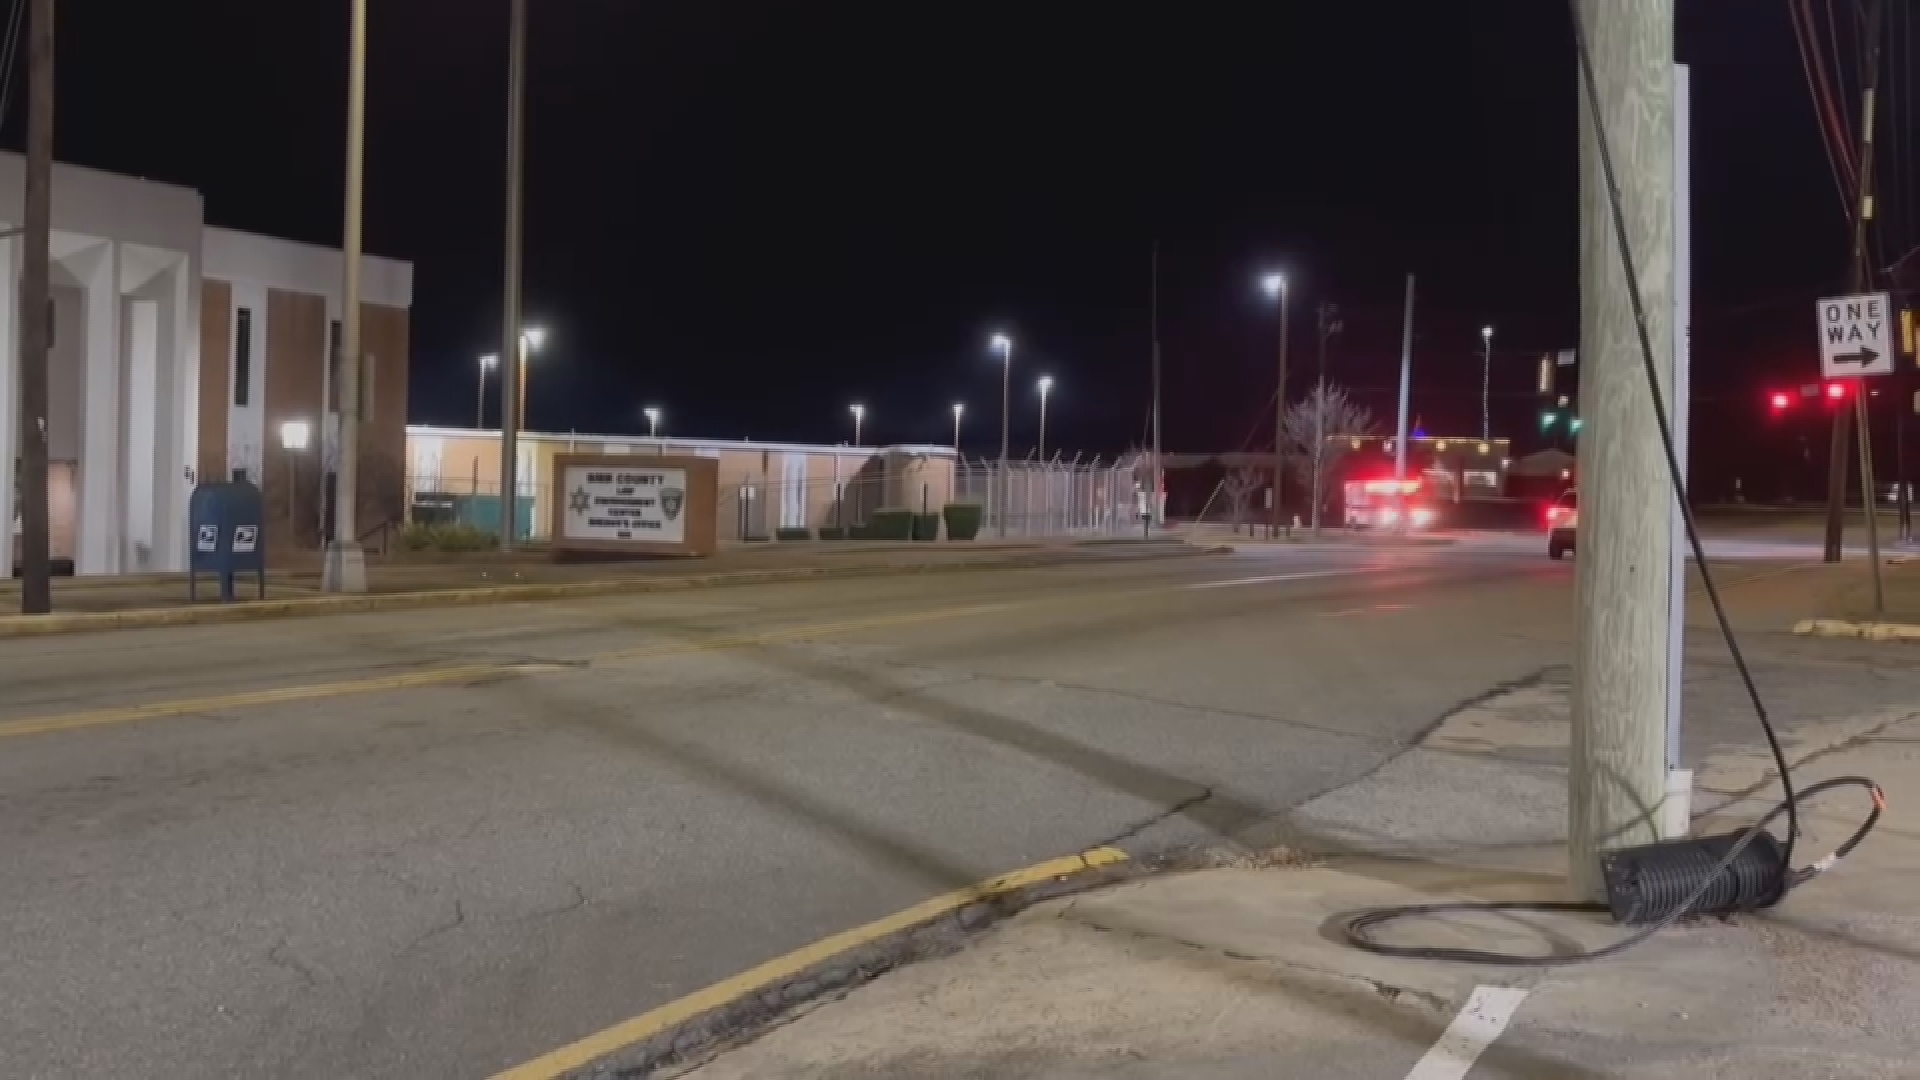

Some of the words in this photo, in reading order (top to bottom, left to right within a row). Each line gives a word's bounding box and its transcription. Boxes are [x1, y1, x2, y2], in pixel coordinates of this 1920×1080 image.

[1826, 300, 1880, 323] ONE
[1827, 321, 1880, 344] WAY
[616, 473, 664, 486] COUNTY
